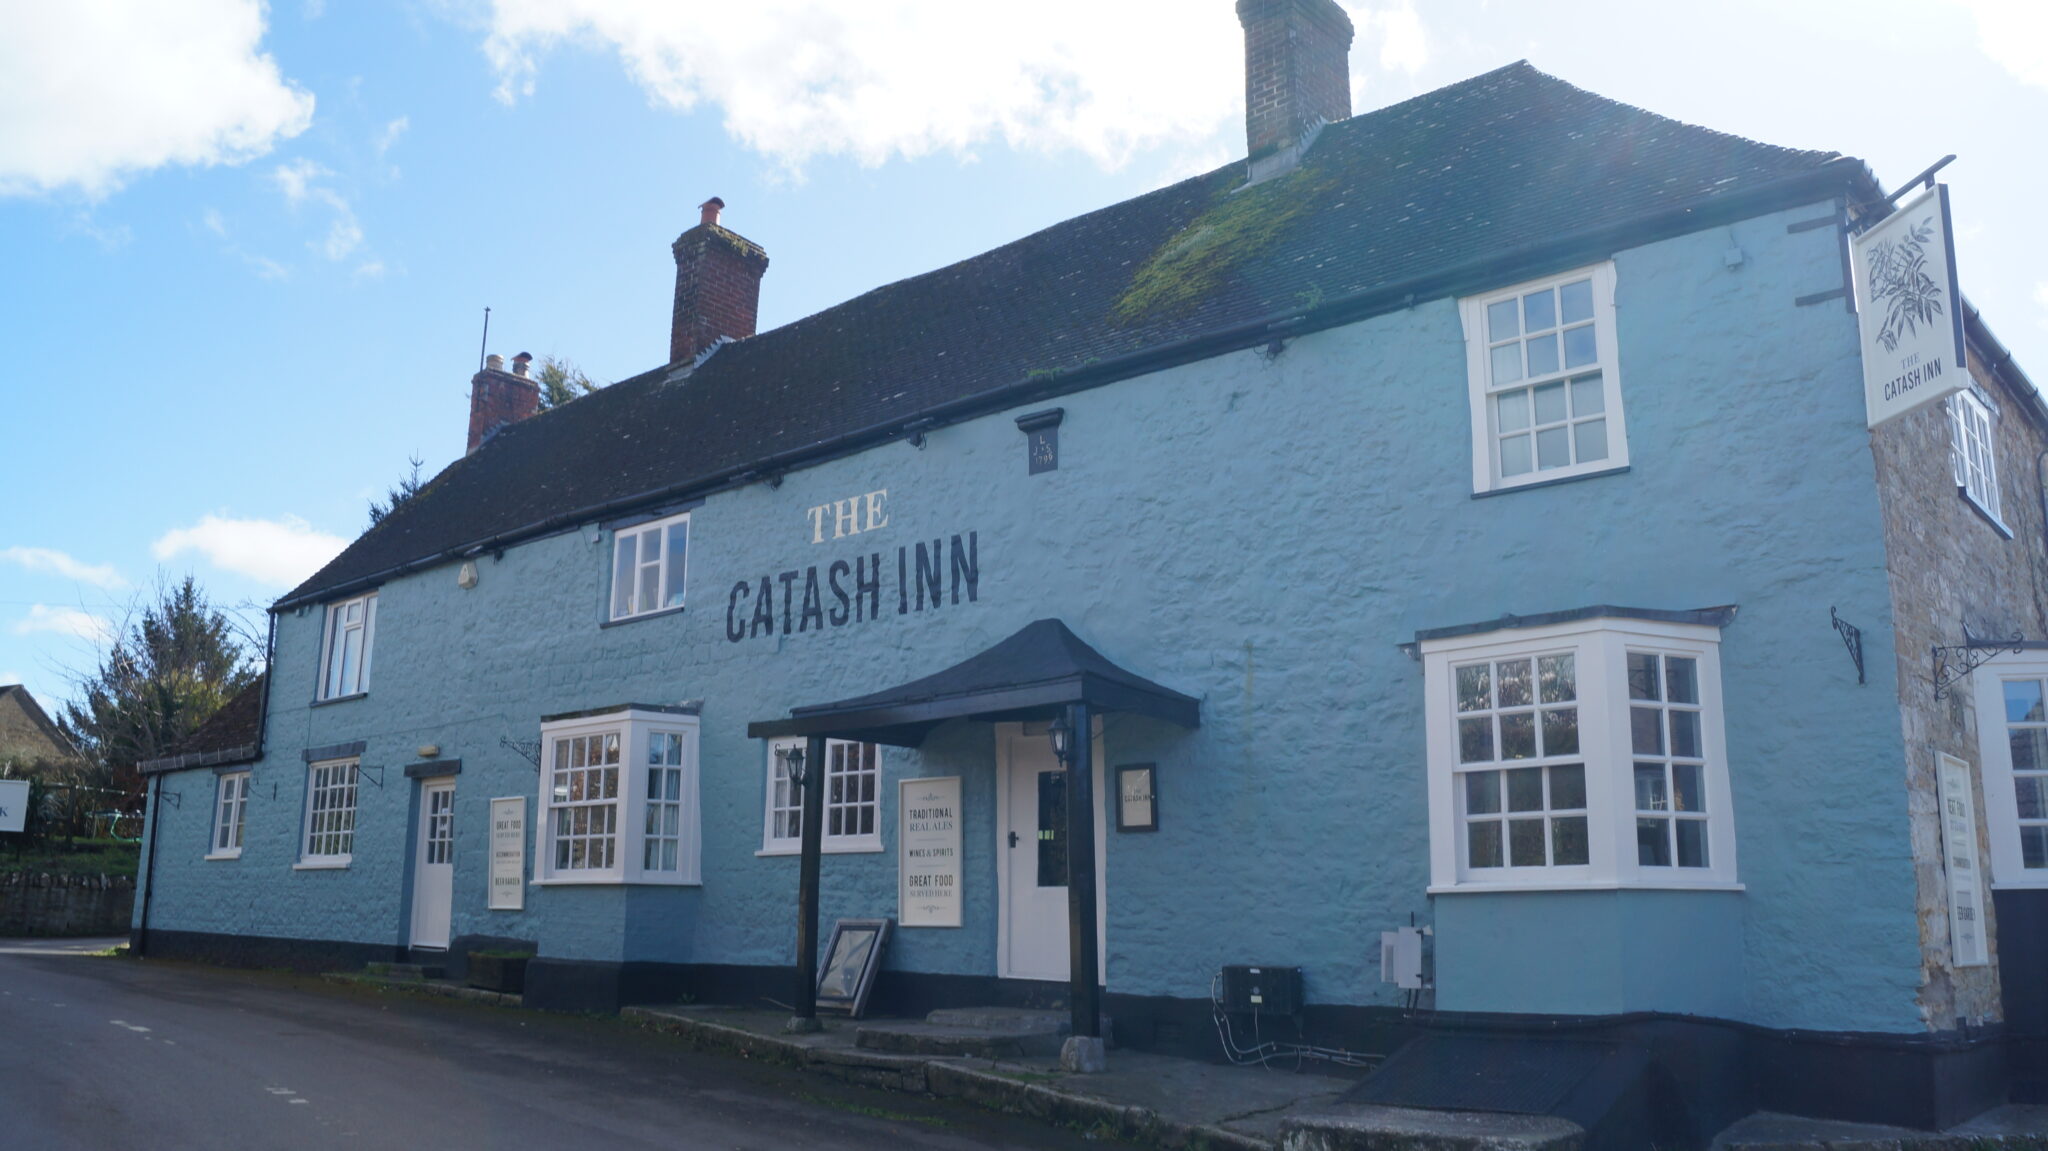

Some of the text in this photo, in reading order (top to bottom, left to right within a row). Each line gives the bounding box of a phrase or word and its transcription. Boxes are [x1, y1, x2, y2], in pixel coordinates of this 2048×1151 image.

[1900, 352, 1921, 370] THE
[1884, 357, 1943, 401] CATASH INN
[807, 488, 889, 544] THE
[726, 531, 979, 643] CATASH INN
[909, 807, 953, 820] TRADITIONAL
[909, 821, 953, 833] REAL ALES
[909, 848, 926, 857] WINES
[933, 848, 953, 857] SPIRITS
[909, 874, 954, 887] GREAT FOOD
